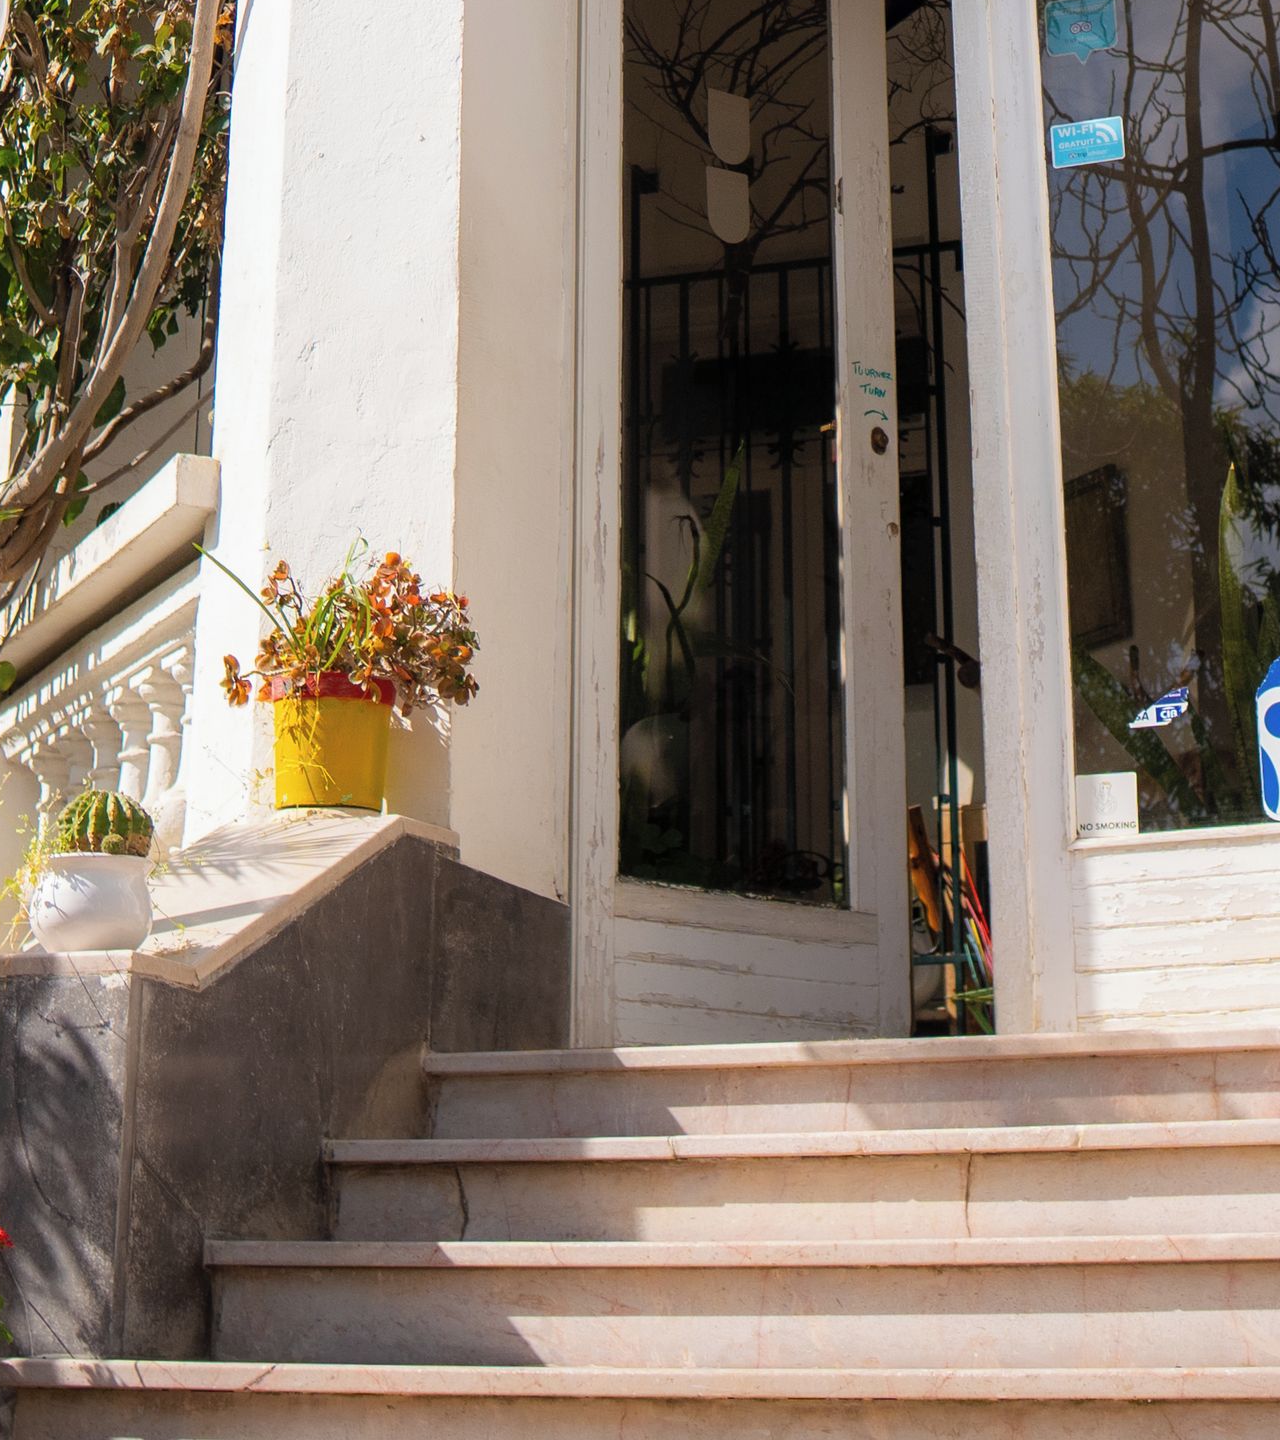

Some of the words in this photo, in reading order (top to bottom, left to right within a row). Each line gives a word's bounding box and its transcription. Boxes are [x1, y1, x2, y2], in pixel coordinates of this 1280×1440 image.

[1057, 123, 1095, 138] WI-FI
[1058, 138, 1095, 150] GRATUIT
[859, 383, 886, 398] TURN
[1080, 823, 1093, 831] NO
[1095, 821, 1137, 830] SMOKING
